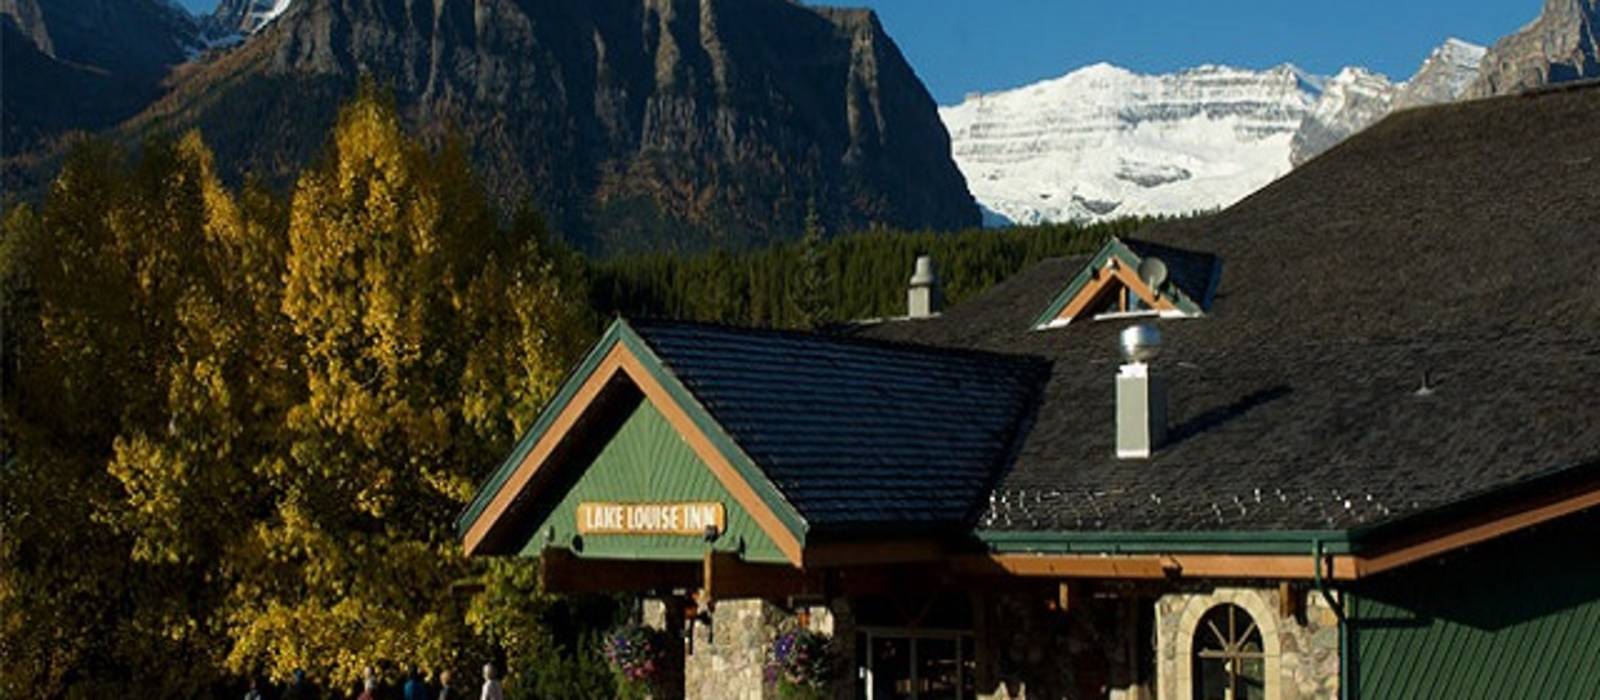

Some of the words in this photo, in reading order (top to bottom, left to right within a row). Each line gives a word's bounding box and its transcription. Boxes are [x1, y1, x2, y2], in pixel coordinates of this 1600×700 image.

[586, 505, 624, 529] LAKE
[627, 505, 679, 530] LOUISE
[684, 504, 717, 529] INN
